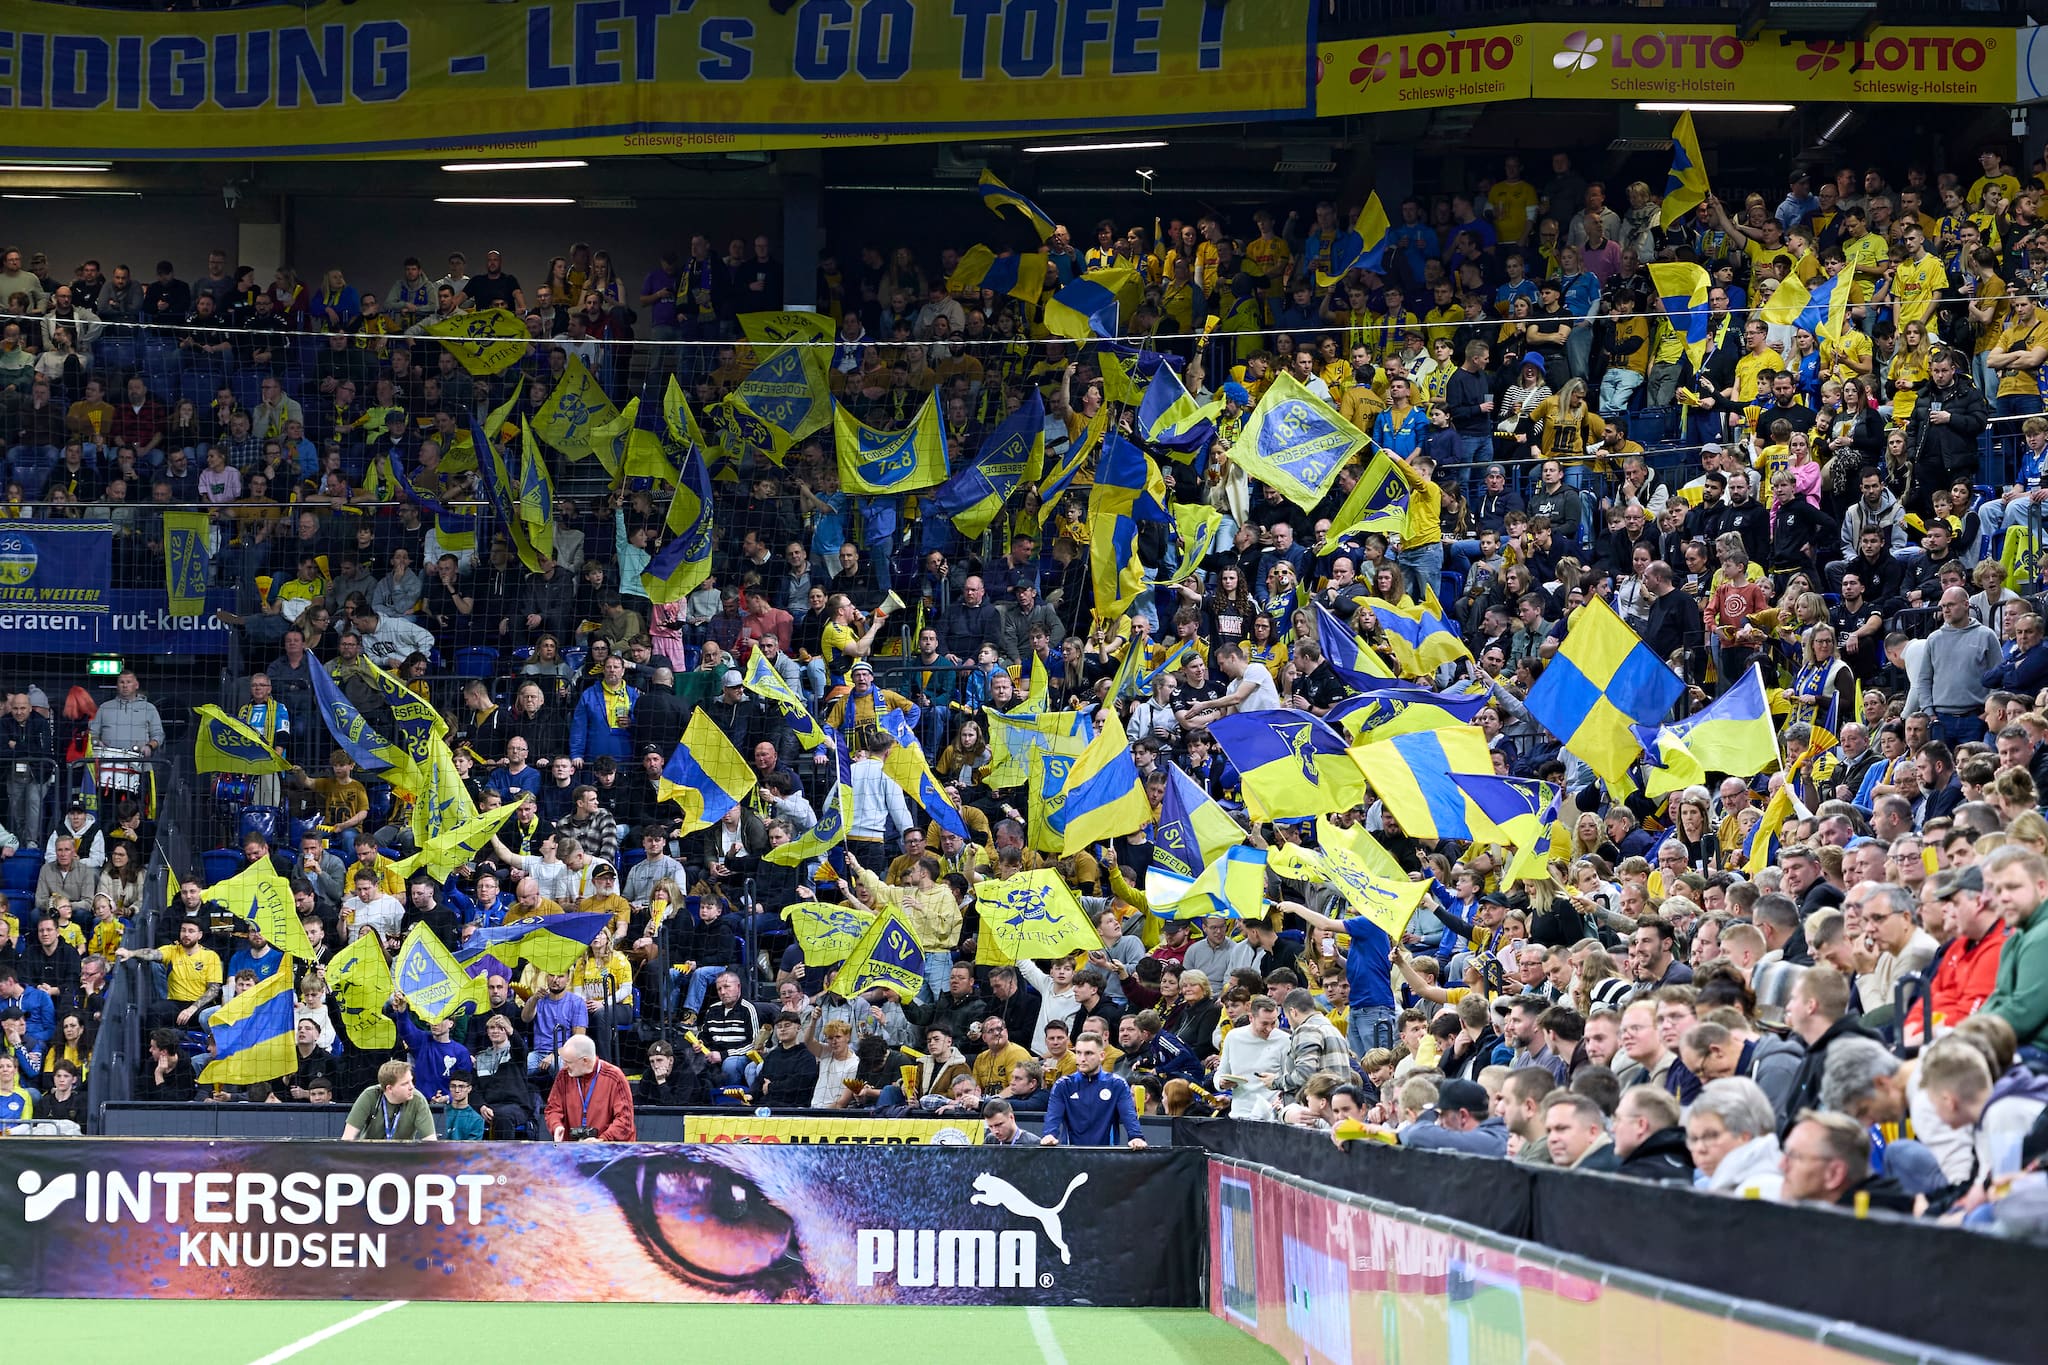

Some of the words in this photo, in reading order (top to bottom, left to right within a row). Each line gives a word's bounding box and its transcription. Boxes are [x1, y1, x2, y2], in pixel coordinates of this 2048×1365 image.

[794, 0, 912, 82] GO
[952, 0, 1162, 80] TOFE
[1611, 35, 1743, 69] LOTTO
[1853, 37, 1986, 71] LOTTO
[1400, 37, 1513, 79] LOTTO
[1399, 80, 1505, 101] Schleswig-Holstein
[1610, 78, 1735, 94] Schleswig-Holstein
[1853, 80, 1977, 94] Schleswig-Holstein
[623, 133, 736, 148] Schleswig-Holstein
[40, 588, 101, 601] WEITER!
[0, 614, 87, 630] eraten.
[1164, 828, 1186, 849] SV
[887, 930, 914, 961] SV
[84, 1170, 495, 1226] INTERSPORT
[179, 1232, 387, 1268] KNUDSEN
[857, 1229, 1037, 1288] PUMA
